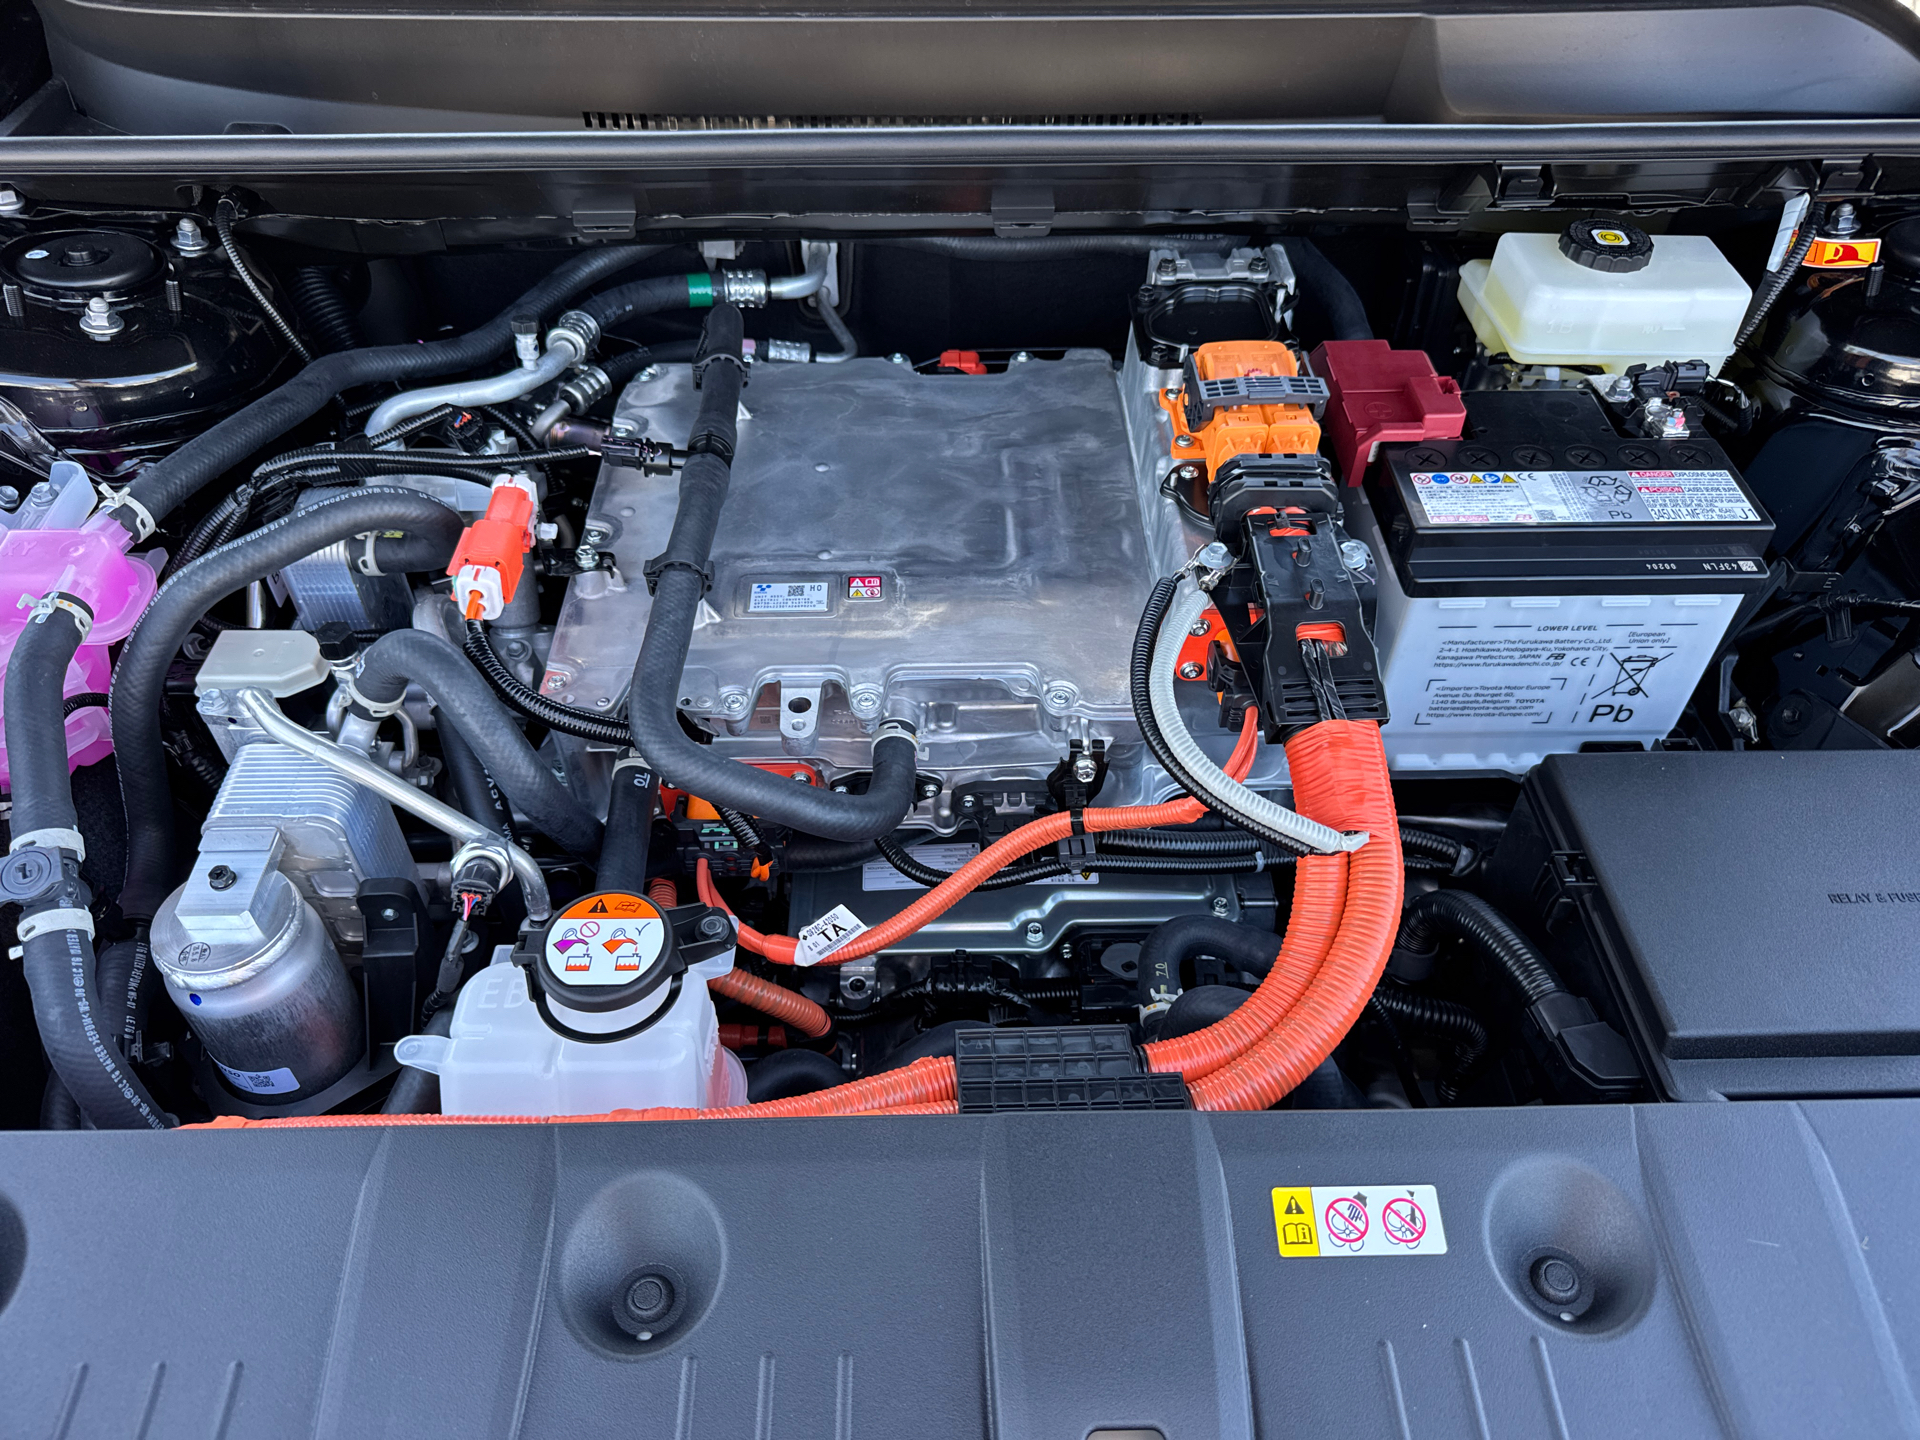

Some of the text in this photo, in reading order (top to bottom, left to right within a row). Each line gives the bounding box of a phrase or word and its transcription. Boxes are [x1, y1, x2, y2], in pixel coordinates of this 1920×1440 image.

[351, 488, 381, 498] WATER
[1608, 511, 1632, 520] Pb
[246, 527, 270, 542] WATER
[149, 585, 168, 607] WATER
[1588, 704, 1634, 722] Pb
[1827, 892, 1872, 904] RELAY
[1874, 892, 1888, 904] &
[816, 923, 848, 942] TA
